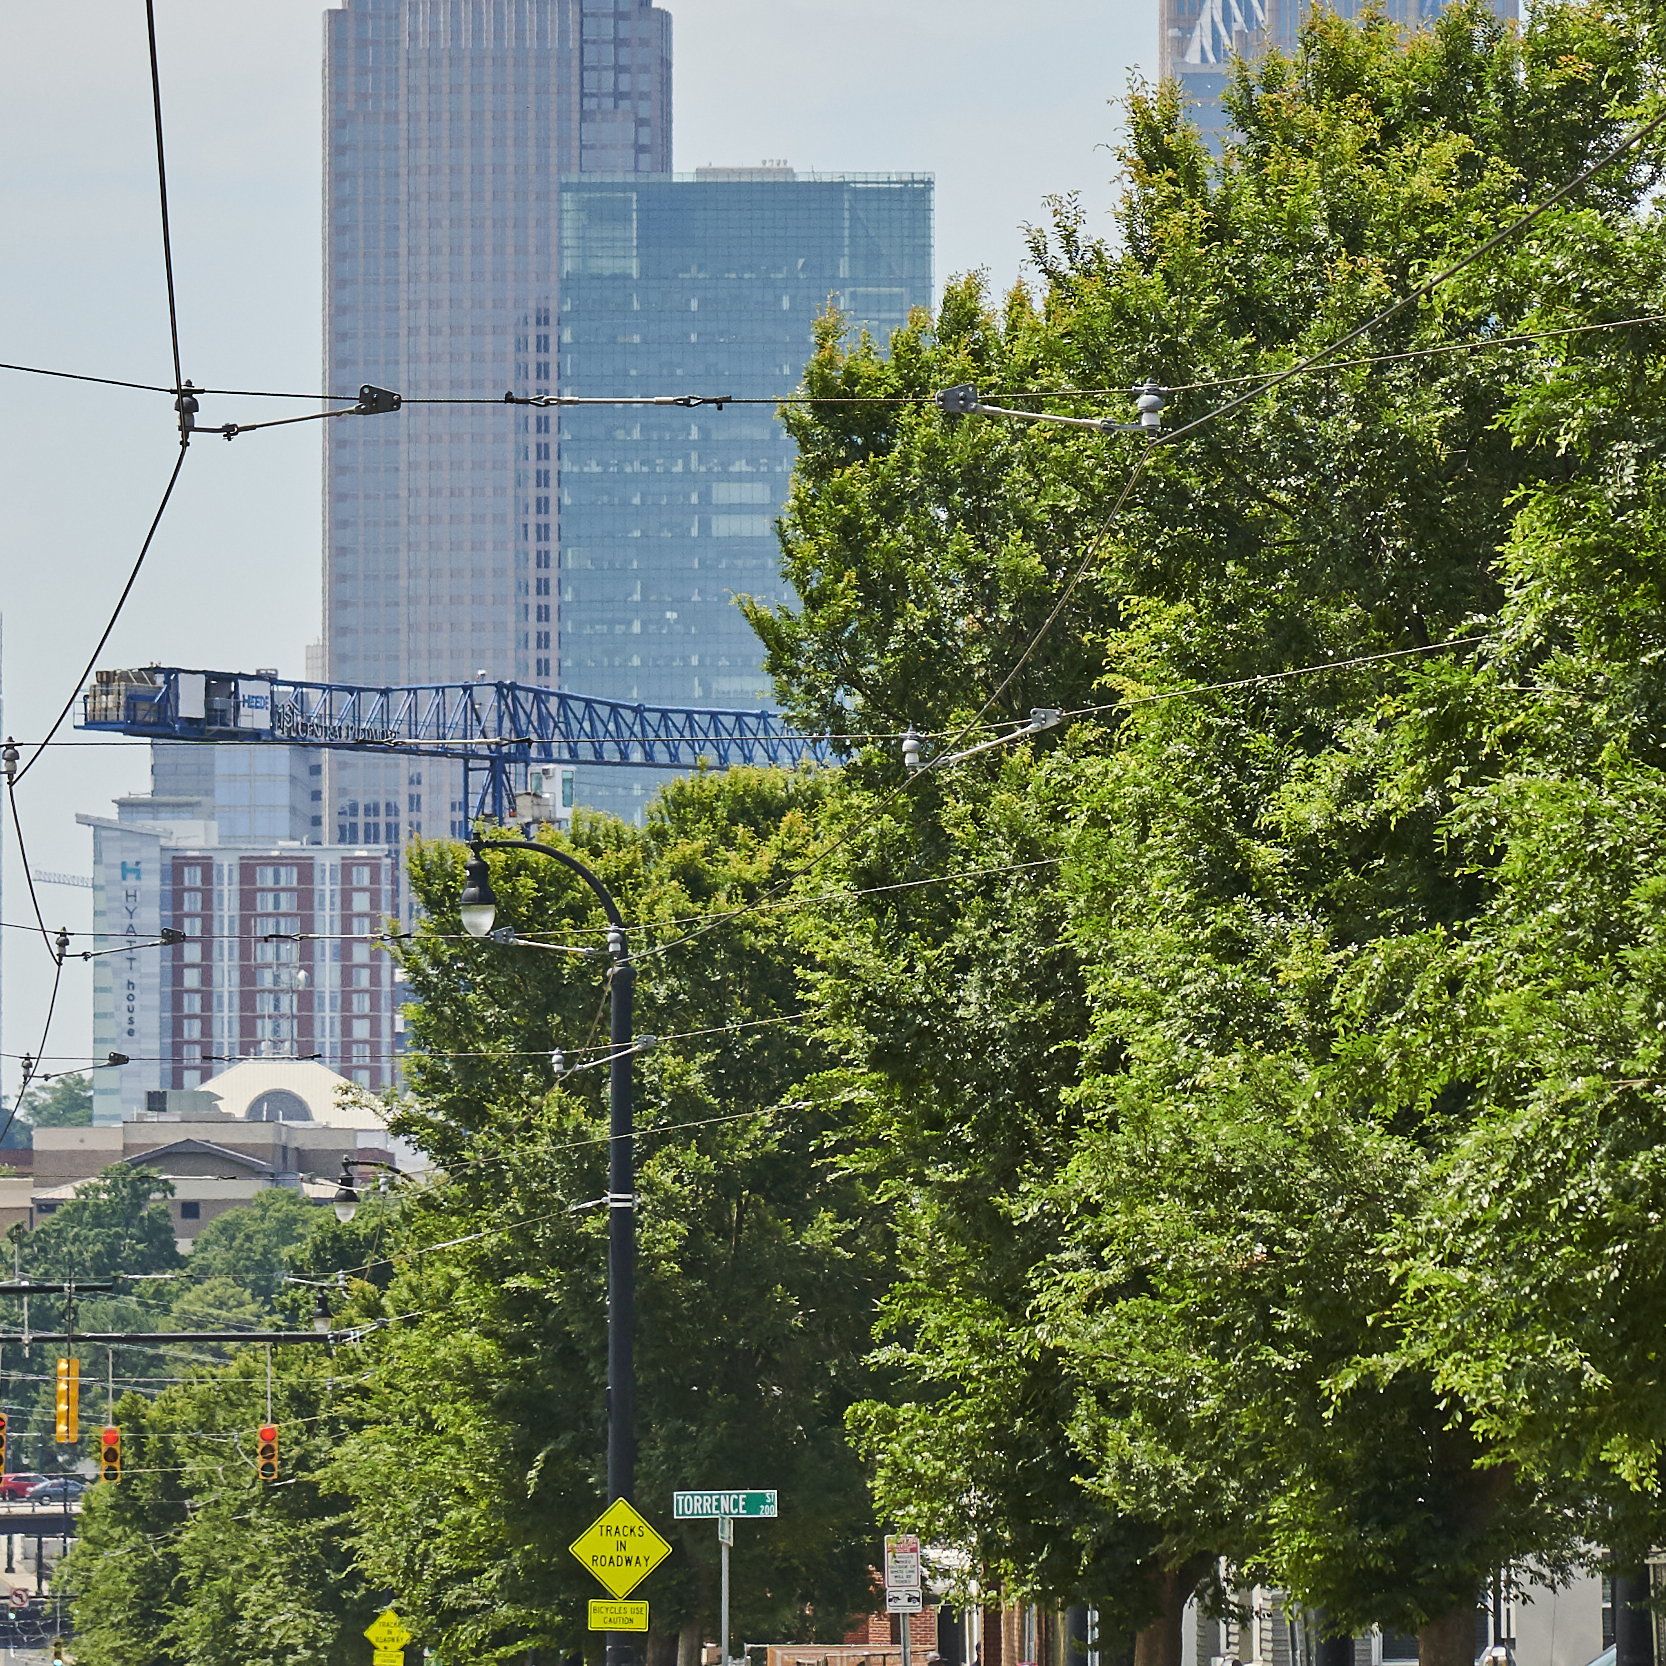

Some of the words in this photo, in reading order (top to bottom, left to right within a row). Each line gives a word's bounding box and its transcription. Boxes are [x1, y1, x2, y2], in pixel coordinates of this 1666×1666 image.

[125, 890, 137, 970] HYATT
[126, 979, 135, 1037] house
[677, 1495, 747, 1514] TORRENCE
[765, 1492, 775, 1503] ST
[759, 1504, 775, 1516] 200
[599, 1525, 645, 1537] TRACKS
[616, 1540, 627, 1552] IN
[591, 1555, 651, 1568] ROADWAY
[592, 1606, 628, 1615] BICYCLES
[630, 1607, 644, 1615] USE
[603, 1616, 634, 1625] CAUTION
